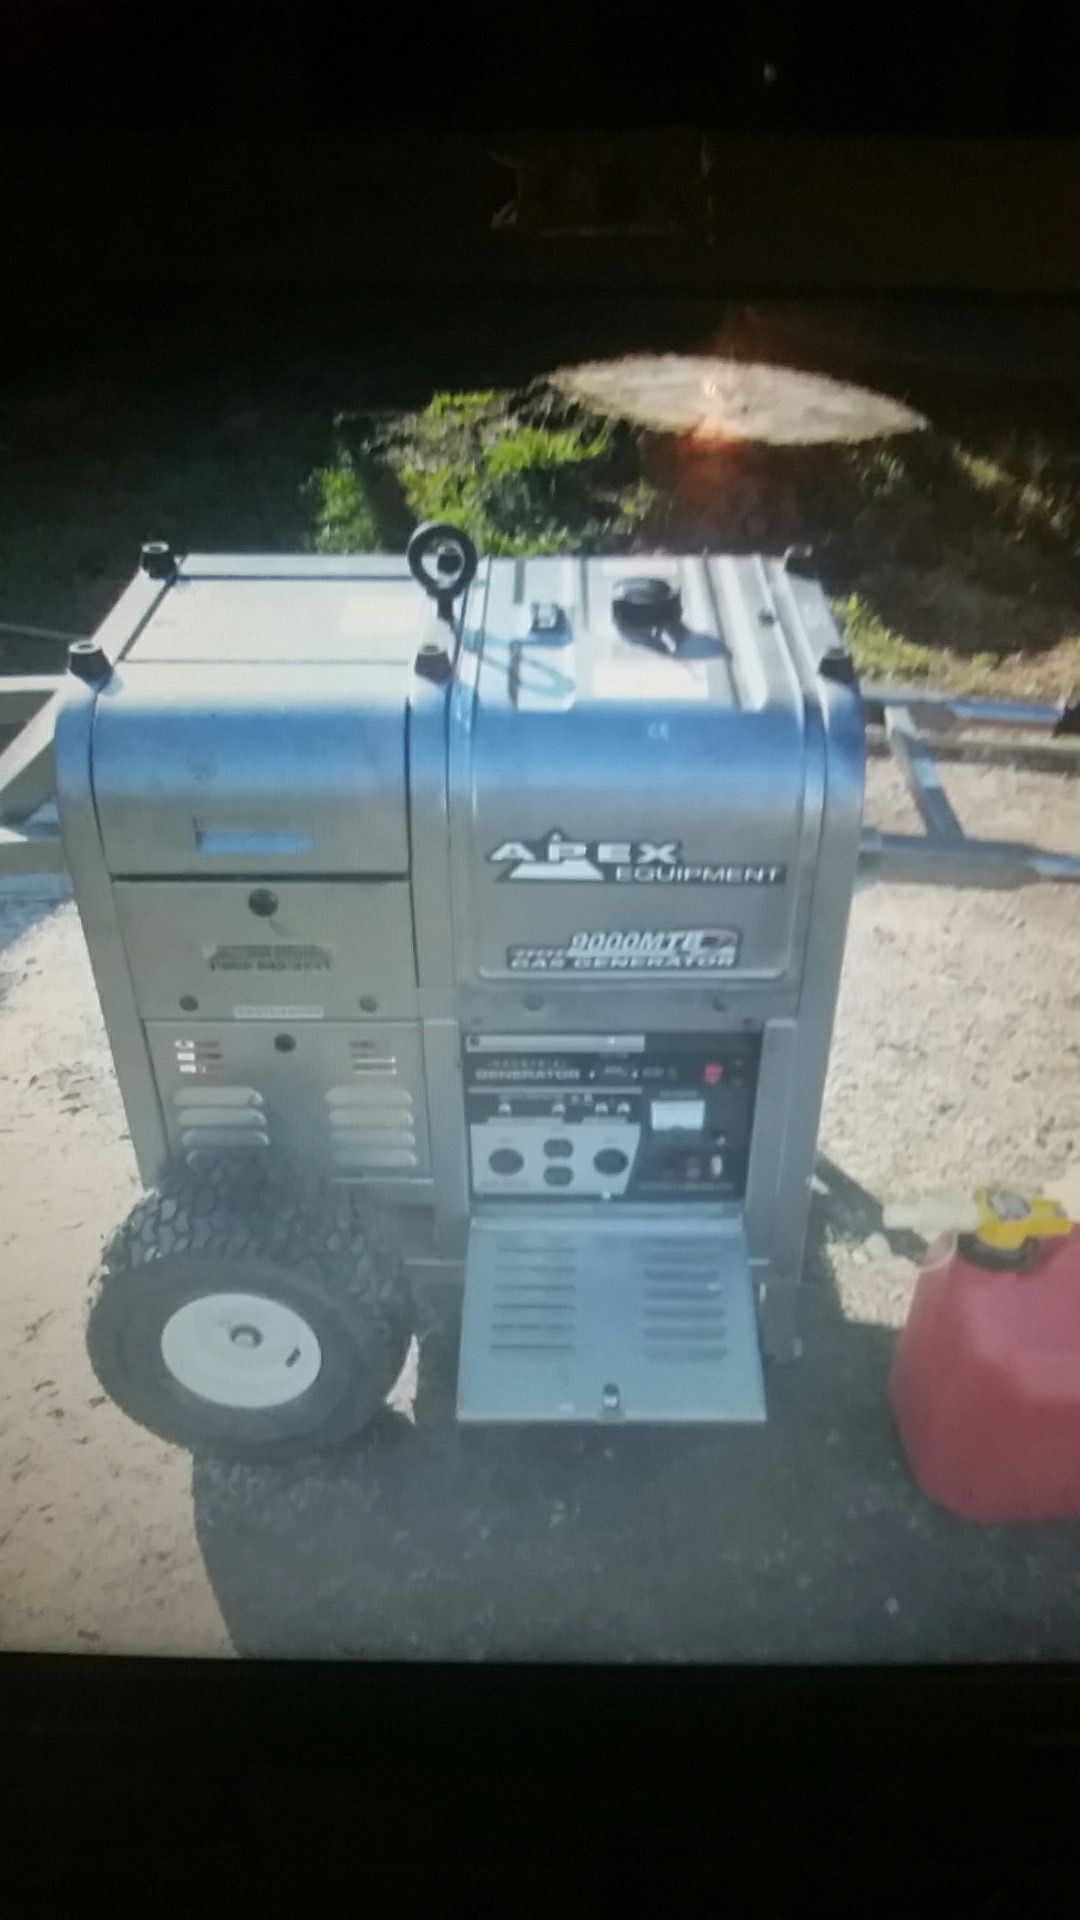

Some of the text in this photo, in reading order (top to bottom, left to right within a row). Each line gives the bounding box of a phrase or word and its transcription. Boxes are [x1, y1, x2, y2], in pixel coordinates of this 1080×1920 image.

[490, 832, 678, 863] APEX
[615, 866, 780, 881] EQUIPMENT
[573, 955, 736, 969] GENERATOR
